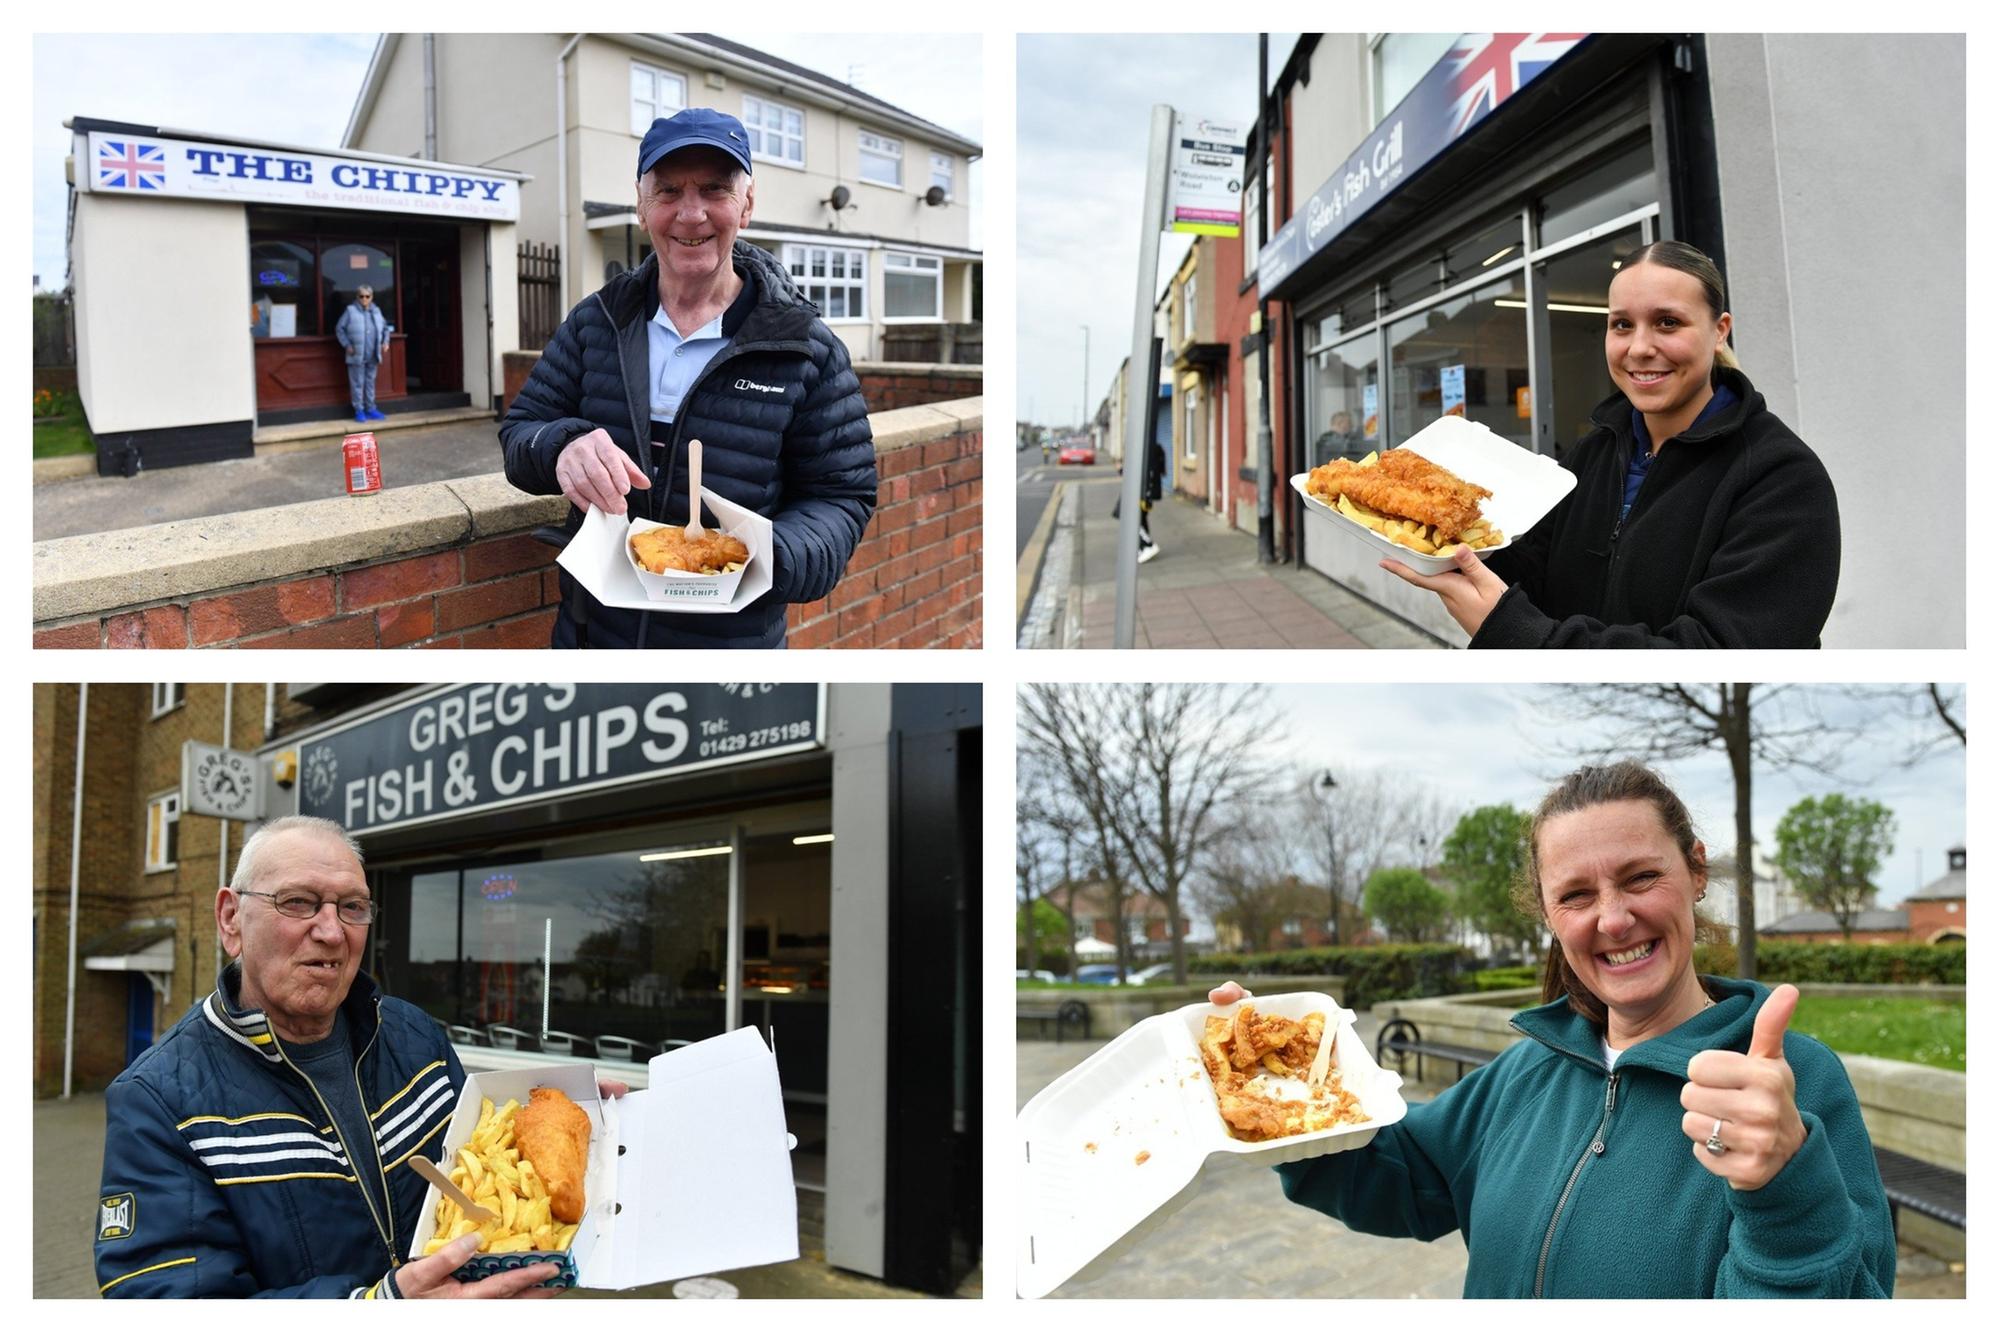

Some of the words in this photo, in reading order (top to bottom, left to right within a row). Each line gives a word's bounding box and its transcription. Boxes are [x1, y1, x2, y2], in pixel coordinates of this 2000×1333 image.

[1194, 141, 1211, 151] Bus
[1212, 143, 1233, 154] Stop
[186, 149, 313, 184] THE
[331, 164, 506, 201] CHIPPY
[1343, 160, 1371, 208] Fish
[1372, 121, 1403, 178] Grill
[1179, 180, 1203, 190] Road
[305, 190, 329, 201] the
[333, 191, 411, 207] traditional
[414, 198, 439, 209] fish
[454, 200, 480, 214] chip
[482, 203, 509, 216] shop
[692, 589, 720, 597] CHIPS
[699, 733, 747, 757] 01429
[749, 720, 812, 748] 275198
[700, 717, 729, 737] Tel:
[198, 752, 252, 785] GREG'S
[345, 759, 433, 829] FISH
[443, 750, 478, 807] &
[490, 691, 690, 796] CHIPS
